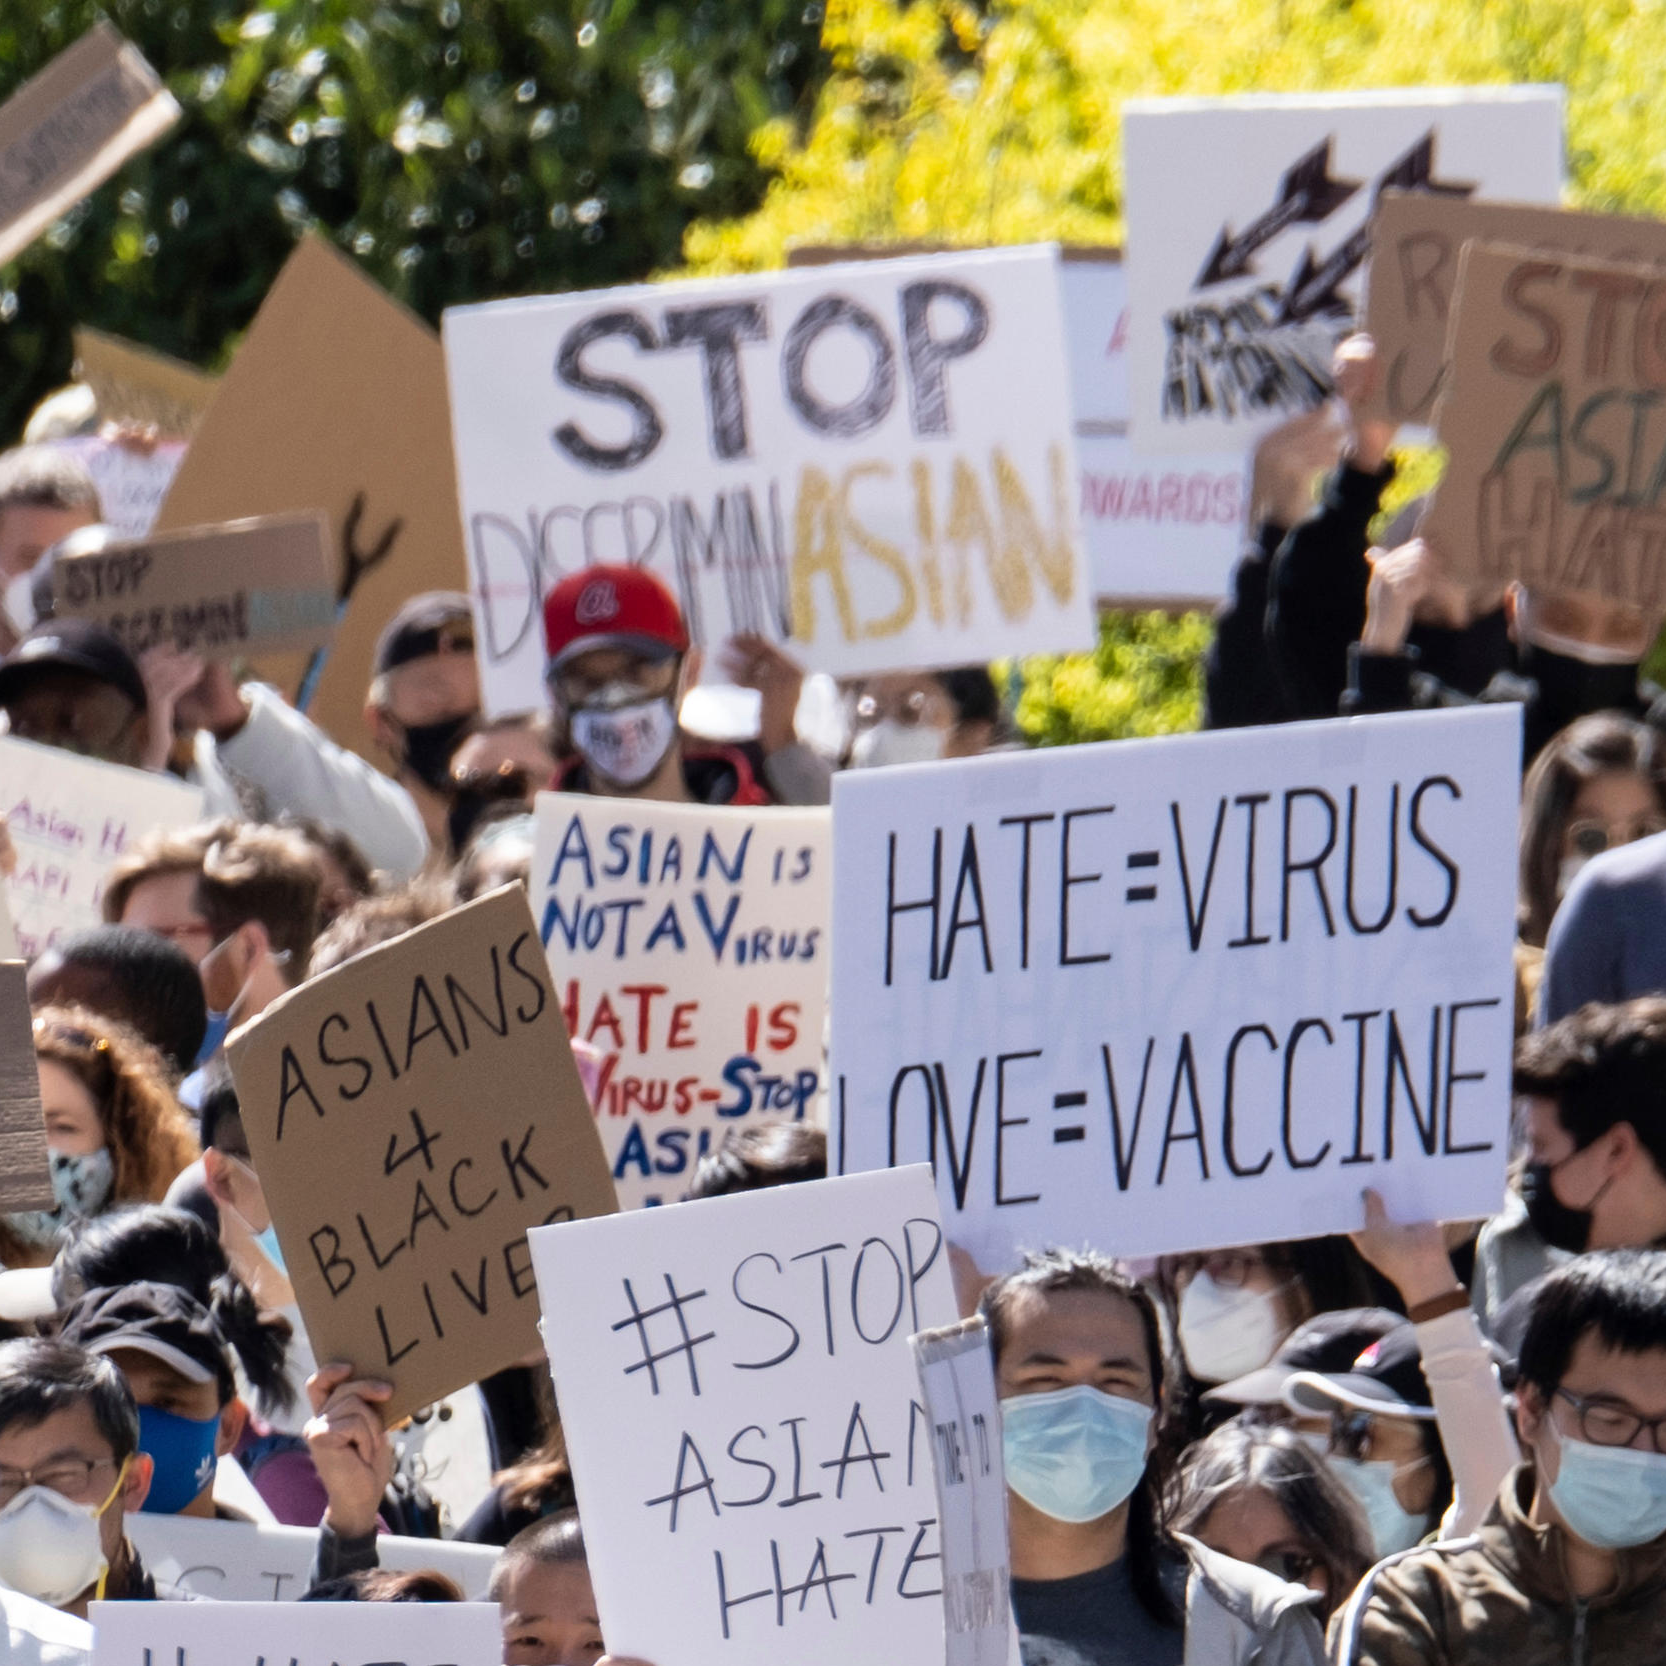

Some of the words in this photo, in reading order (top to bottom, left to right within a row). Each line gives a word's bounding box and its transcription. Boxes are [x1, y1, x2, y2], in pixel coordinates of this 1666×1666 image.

[552, 280, 989, 473] STOP
[548, 813, 753, 888] ASIAN
[771, 846, 813, 882] IS
[541, 897, 641, 956] NOT
[647, 901, 685, 950] A
[276, 931, 546, 1141] ASIANS
[746, 1005, 798, 1053] IS
[384, 1108, 441, 1175] 4
[309, 1125, 549, 1298] BLACK
[611, 1218, 943, 1397] #STOP
[714, 1519, 943, 1639] HATE
